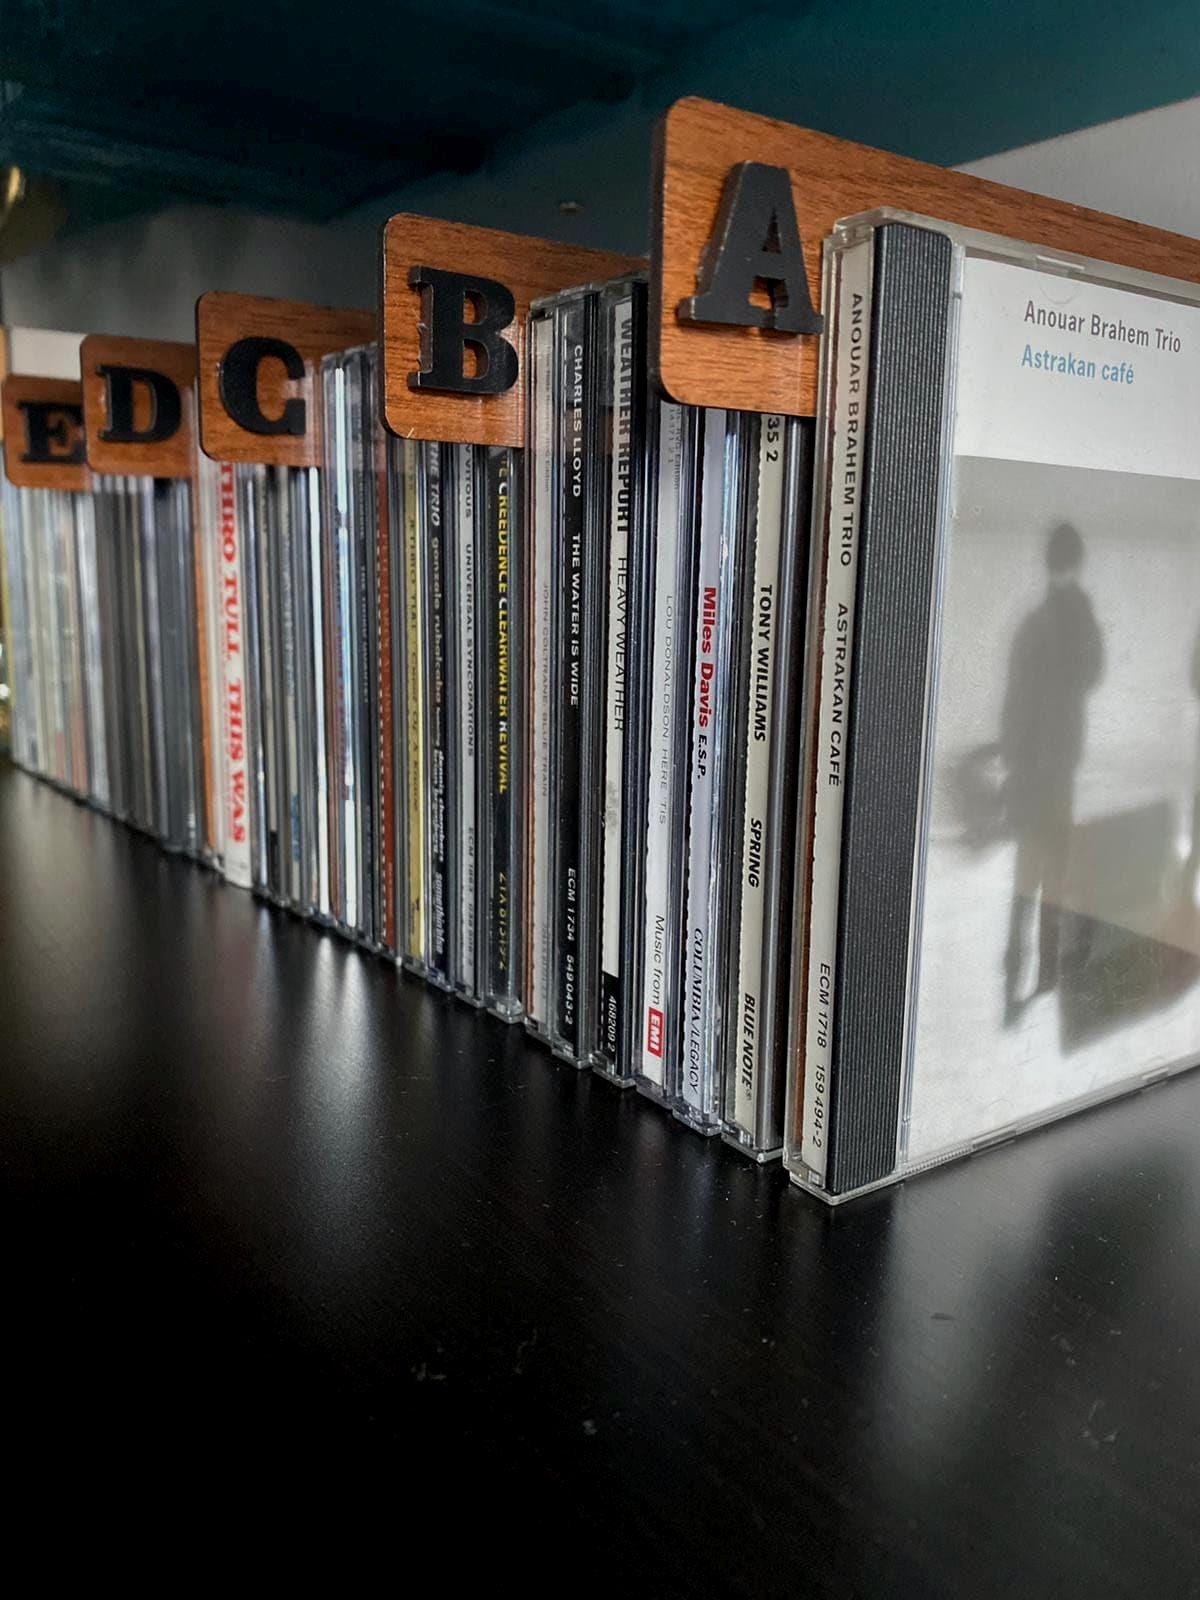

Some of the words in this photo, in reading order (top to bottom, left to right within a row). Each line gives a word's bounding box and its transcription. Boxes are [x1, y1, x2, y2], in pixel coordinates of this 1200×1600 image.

[677, 160, 823, 334] A
[407, 265, 520, 396] B
[848, 292, 863, 394] ANOUAR
[1024, 300, 1085, 333] Anouar
[1090, 314, 1149, 347] Brahem
[1155, 327, 1181, 353] Trio
[218, 335, 307, 436] C
[573, 344, 583, 432] CHARLES
[619, 318, 632, 436] WEATHER
[1021, 344, 1096, 379] Astrakan
[1101, 362, 1135, 385] café
[17, 401, 86, 464] E
[96, 364, 182, 443] D
[572, 437, 582, 498] LLOYD
[843, 402, 860, 505] BRAHEM
[430, 482, 440, 527] TRIO
[617, 442, 630, 535] REPORT
[498, 482, 509, 593] CREEDENCE
[571, 533, 581, 569] THE
[840, 512, 854, 567] TRIO
[432, 537, 442, 609] gonzalo
[571, 573, 580, 635] WATER
[616, 557, 628, 628] HEAVY
[225, 571, 240, 660] TULL
[665, 595, 673, 630] LOU
[702, 587, 717, 654] Miles
[758, 584, 773, 642] TONY
[434, 614, 443, 703] rubalcaba
[498, 597, 508, 717] CLEARWATER
[571, 639, 580, 656] IS
[832, 603, 849, 723] ASTRAKAN
[571, 661, 580, 705] WIDE
[614, 632, 627, 732] WEATHER
[699, 662, 713, 728] Davis
[753, 647, 769, 742] WILLIAMS
[228, 679, 244, 760] THIS
[499, 721, 508, 794] REVIVAL
[659, 748, 669, 790] HERE
[697, 734, 707, 779] E.S.P.
[828, 731, 842, 787] CAFÉ
[231, 768, 246, 843] WAS
[568, 868, 577, 901] ECM
[748, 818, 762, 888] SPRING
[567, 906, 575, 941] 1734
[653, 915, 665, 964] Music
[651, 968, 664, 1005] from
[743, 993, 756, 1036] BLUE
[819, 963, 831, 1005] ECM
[650, 1013, 660, 1052] EMI
[816, 1010, 829, 1048] 1718
